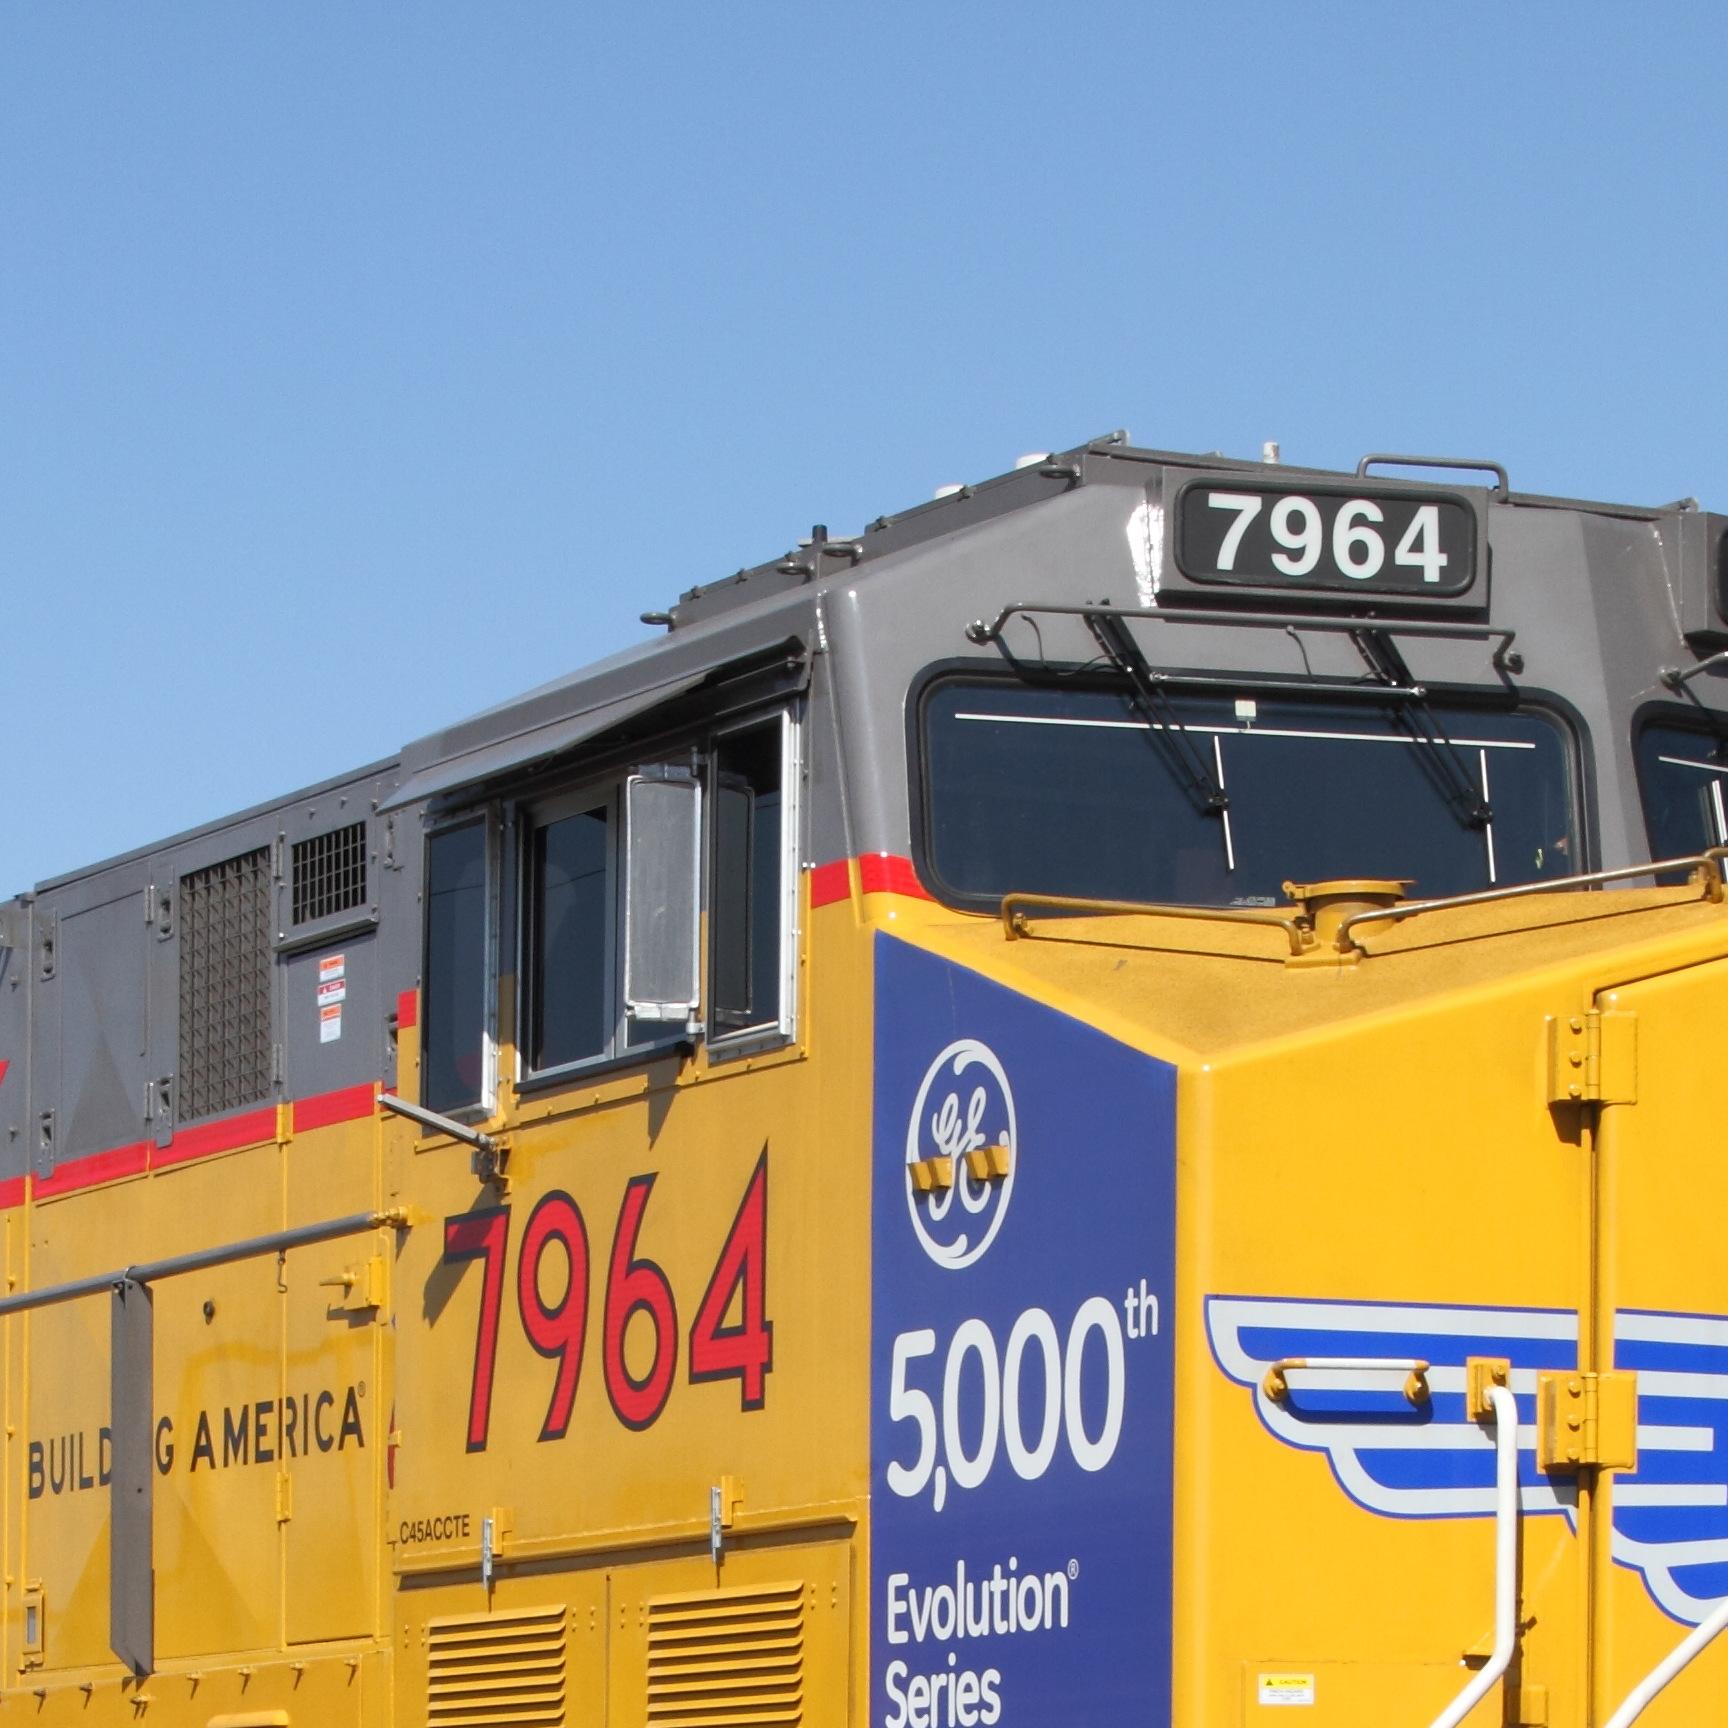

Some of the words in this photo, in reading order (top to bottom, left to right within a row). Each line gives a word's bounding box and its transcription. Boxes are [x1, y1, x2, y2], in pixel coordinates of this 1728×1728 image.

[1207, 492, 1449, 584] 7964
[443, 1136, 773, 1454] 7964
[28, 1415, 175, 1500] BUILDG
[399, 1513, 471, 1546] C45ACCTE
